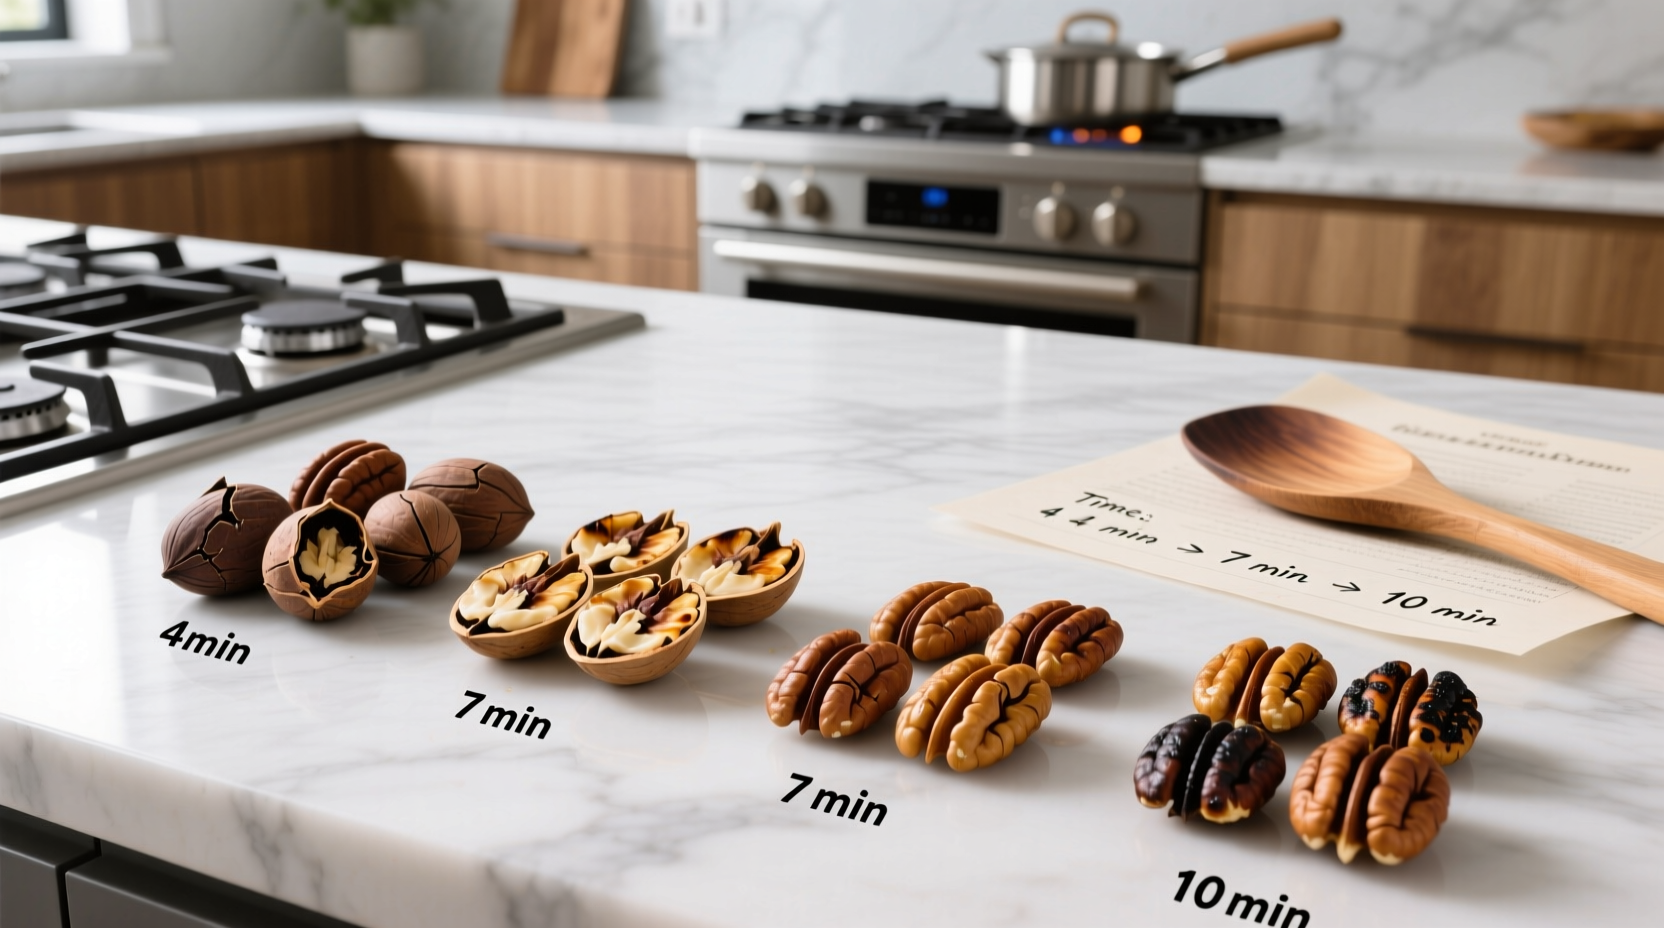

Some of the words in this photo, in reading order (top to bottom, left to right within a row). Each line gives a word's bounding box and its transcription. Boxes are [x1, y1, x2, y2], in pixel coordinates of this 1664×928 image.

[1099, 526, 1158, 544] min
[1220, 550, 1252, 564] 7
[1248, 563, 1308, 583] min
[1382, 591, 1429, 609] 10
[1430, 607, 1497, 626] min
